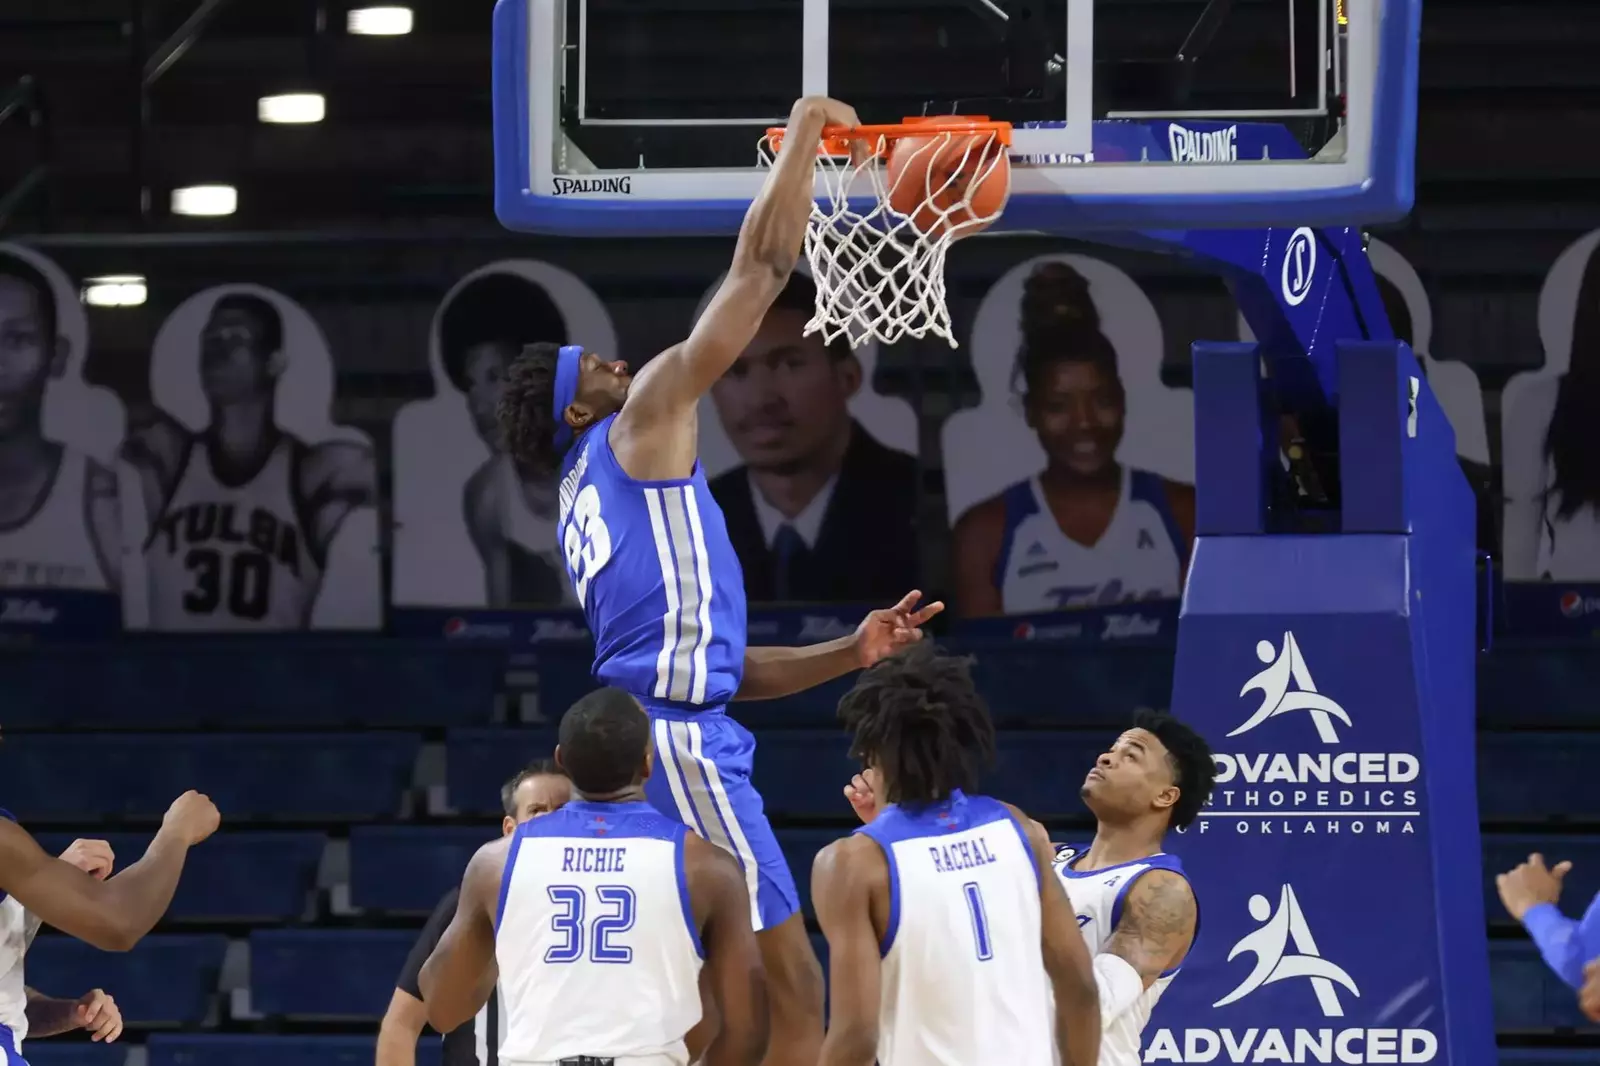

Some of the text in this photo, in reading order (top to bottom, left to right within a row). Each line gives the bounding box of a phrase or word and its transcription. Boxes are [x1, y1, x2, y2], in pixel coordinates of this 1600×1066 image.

[1168, 122, 1236, 162] SPALDING
[552, 176, 631, 196] SPALDING
[184, 549, 269, 619] 30
[1209, 753, 1419, 784] DVANCED
[1202, 790, 1416, 806] THOPEDICS
[1236, 820, 1414, 834] OKLAHOMA
[562, 847, 626, 873] RICHIE
[928, 837, 996, 873] RACHAL
[544, 885, 637, 964] 32
[962, 881, 993, 961] 1
[1143, 1028, 1438, 1064] ADVANCED
